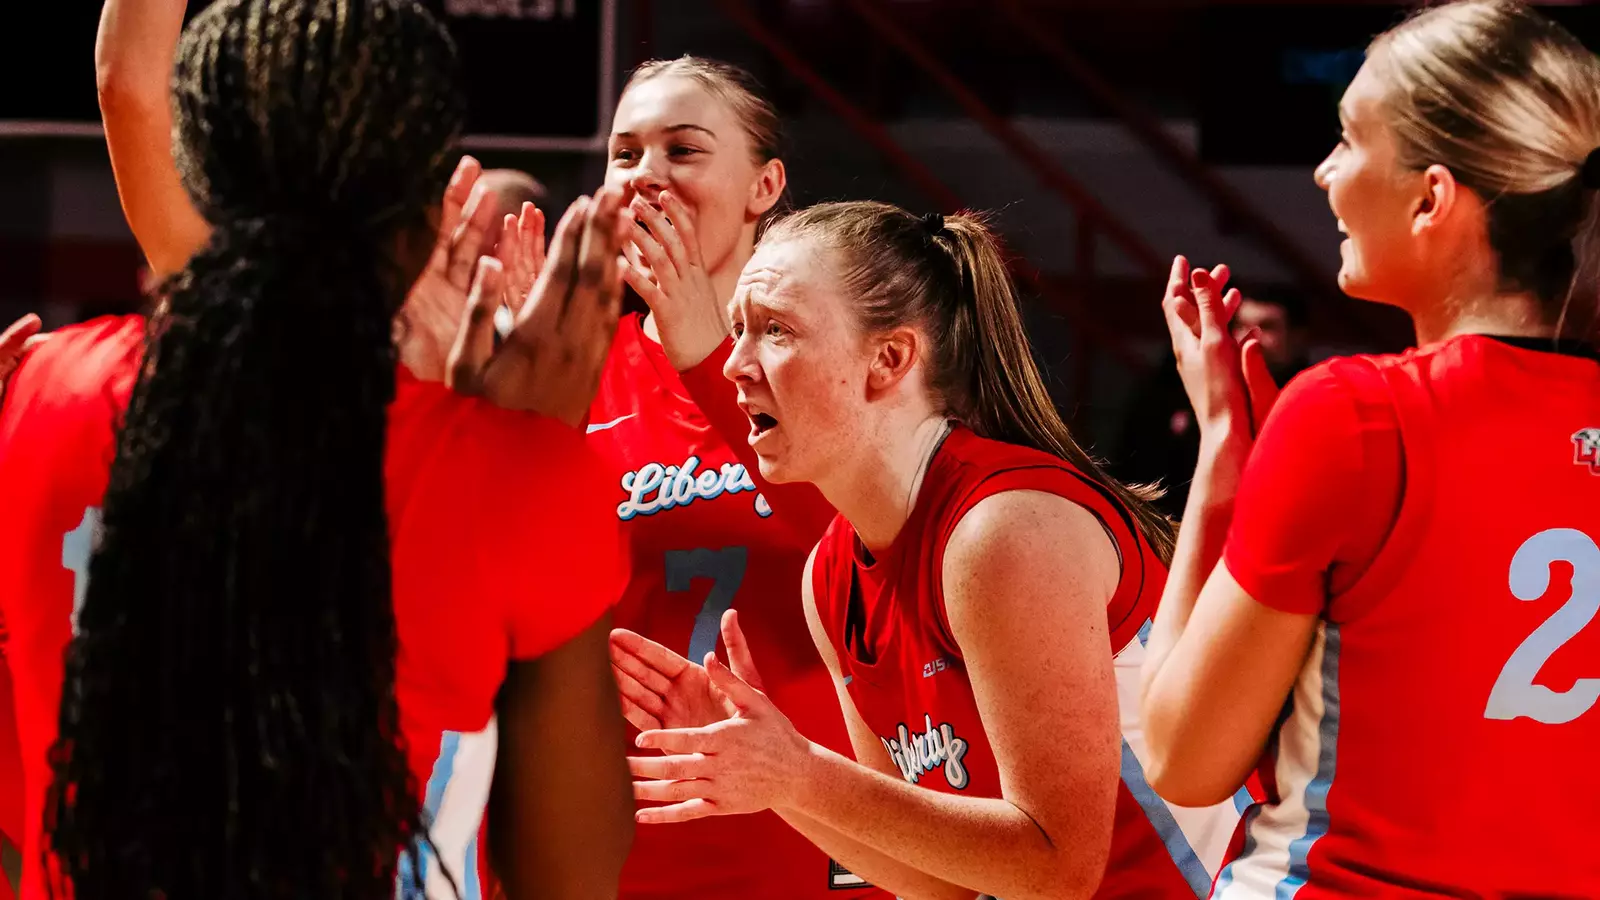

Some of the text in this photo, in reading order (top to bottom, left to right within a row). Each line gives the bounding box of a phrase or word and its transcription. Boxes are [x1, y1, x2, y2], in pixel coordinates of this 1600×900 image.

[616, 455, 773, 521] Liber
[665, 546, 748, 667] 7
[1483, 528, 1600, 724] 2
